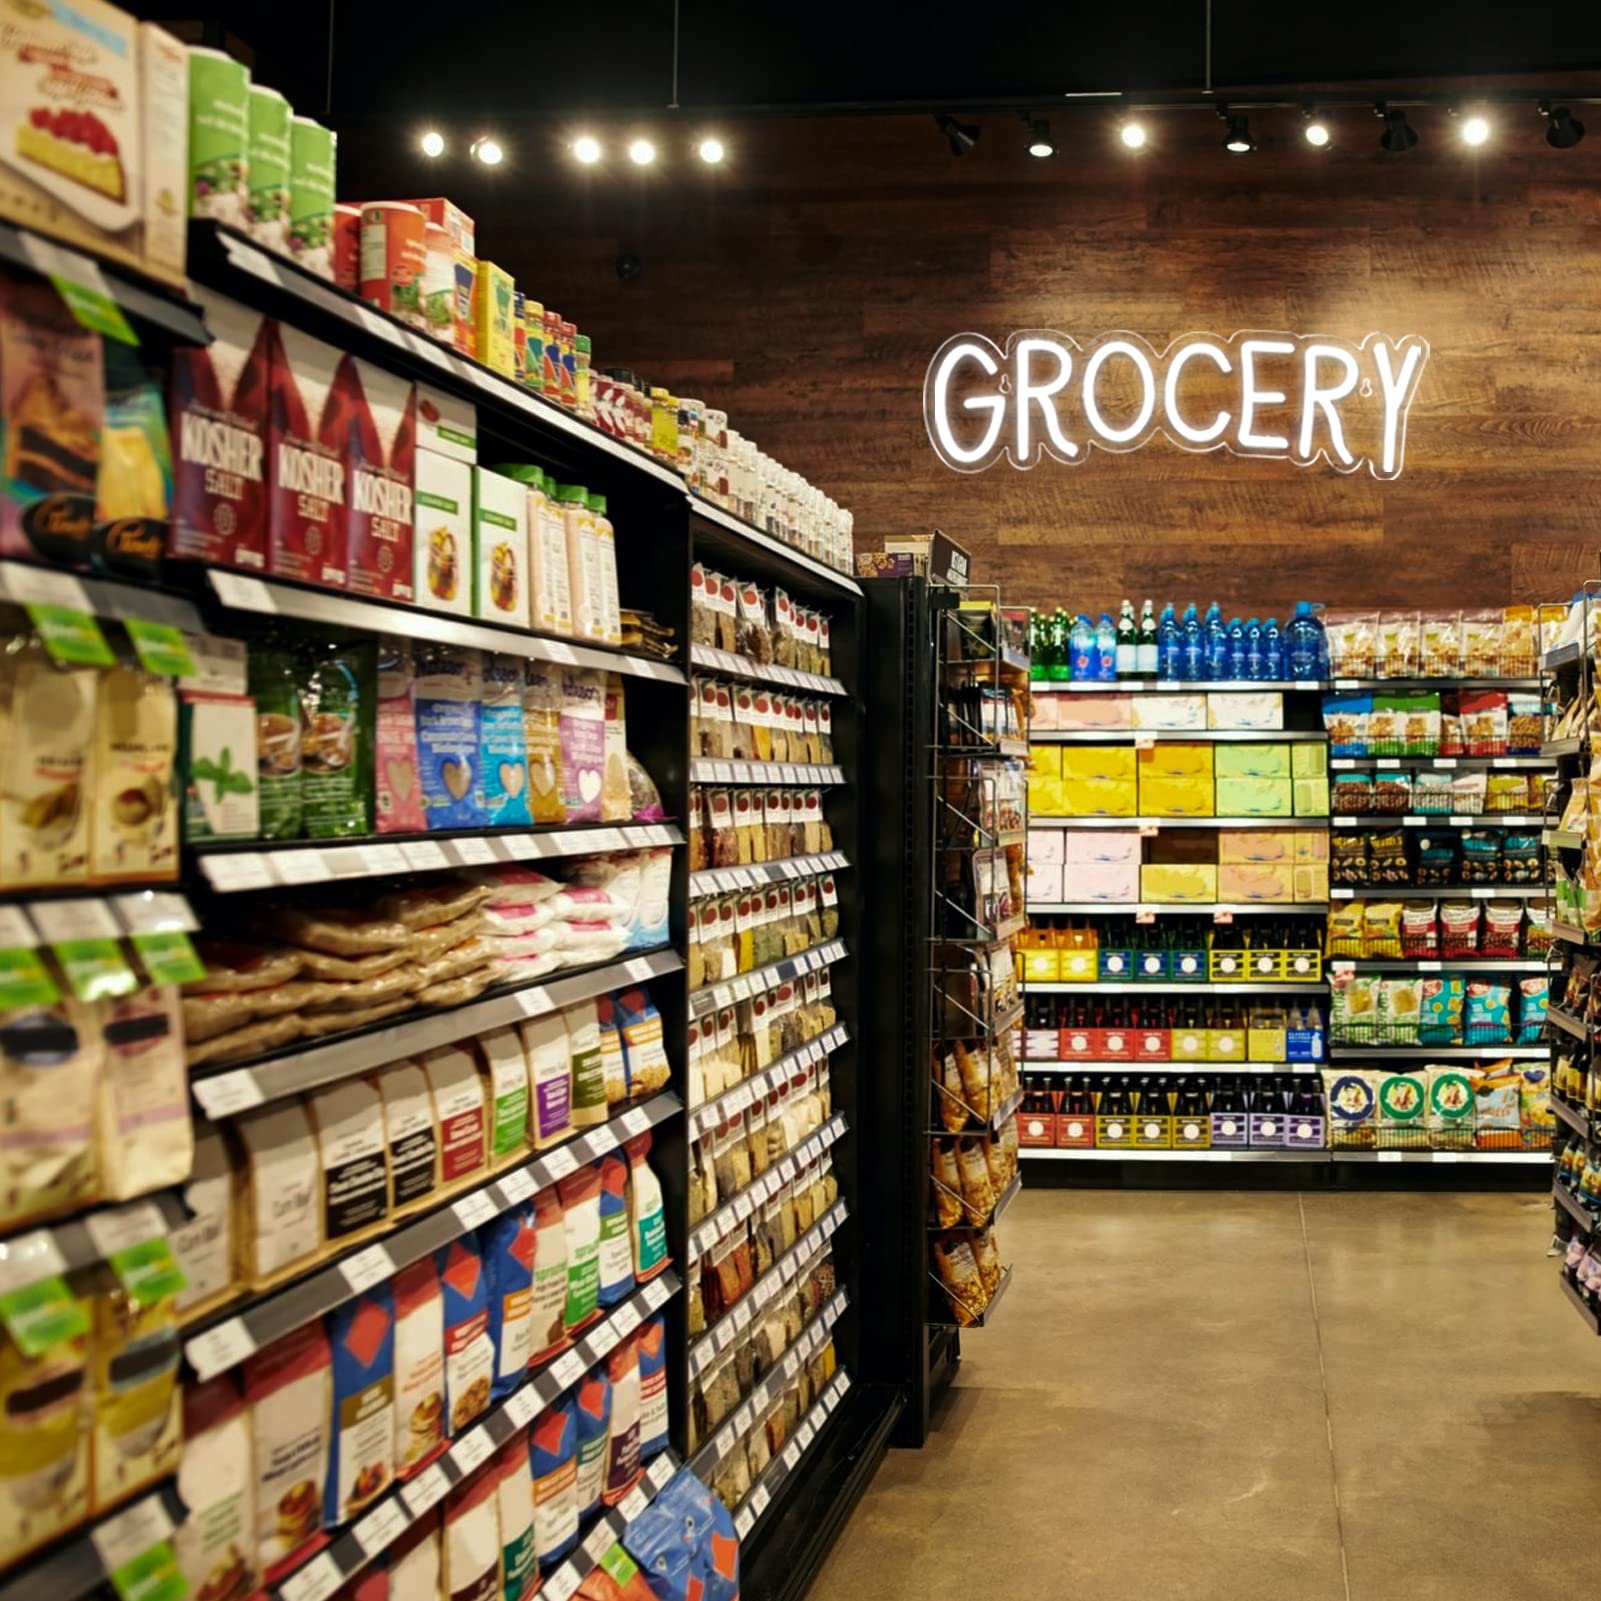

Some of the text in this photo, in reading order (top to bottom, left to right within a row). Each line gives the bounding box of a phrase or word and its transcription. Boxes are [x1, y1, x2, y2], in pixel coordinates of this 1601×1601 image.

[934, 338, 1422, 474] GROCERY
[180, 411, 264, 482] KOSHER
[278, 442, 344, 504] KOSHER
[205, 468, 244, 500] SALT
[297, 494, 330, 523] SALT
[353, 469, 413, 526] KOSHER
[371, 516, 400, 543] SALT
